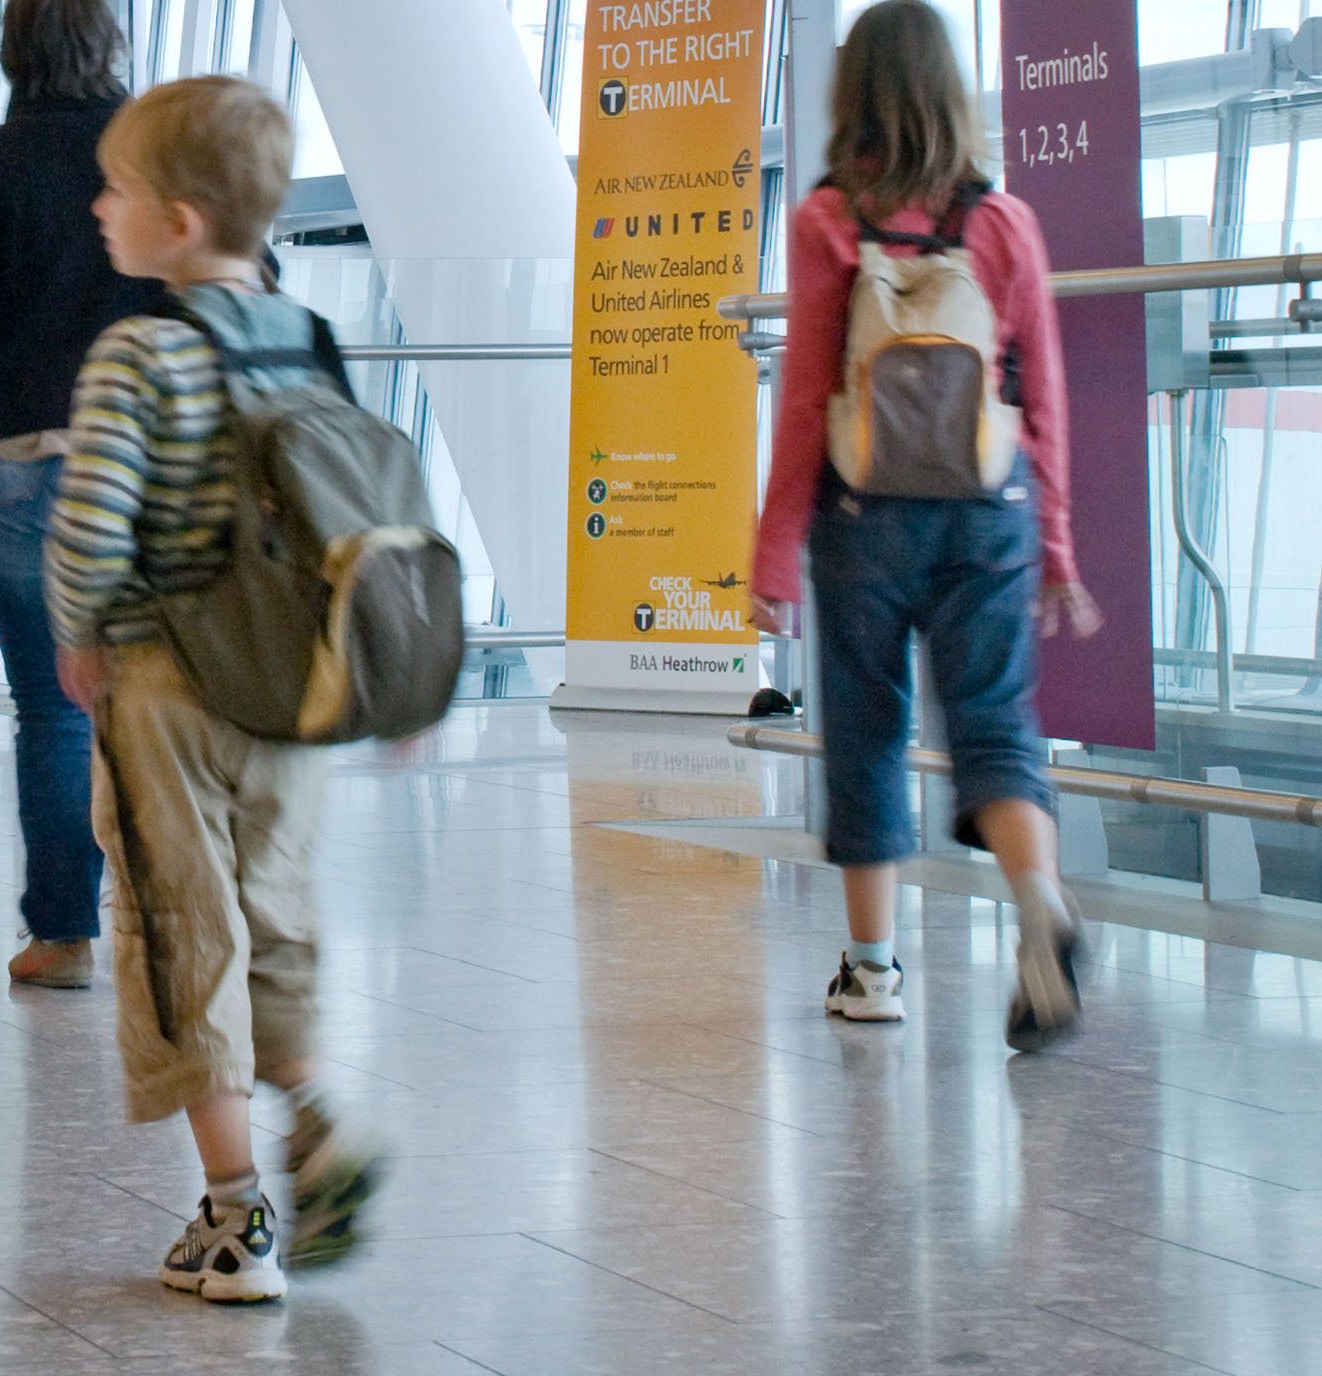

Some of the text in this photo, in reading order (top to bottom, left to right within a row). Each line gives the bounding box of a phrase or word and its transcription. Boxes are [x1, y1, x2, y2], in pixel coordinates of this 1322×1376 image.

[598, 30, 753, 70] TO THE RIGHT
[1015, 41, 1108, 91] Terminals
[601, 77, 731, 115] TERMINAL
[594, 170, 729, 194] AIR NEW ZEALAND
[626, 209, 753, 237] UNITED
[591, 254, 744, 281] Air New Zealand &
[592, 289, 710, 313] United Airlines
[590, 319, 739, 348] now operate from
[589, 354, 669, 376] Terminal 1
[669, 480, 716, 490] connections
[610, 493, 678, 502] information board
[616, 528, 645, 537] member
[649, 576, 692, 590] CHECK
[664, 592, 710, 609] YOUR
[637, 609, 745, 631] TERMINAL
[630, 655, 729, 673] BAA Heathrow
